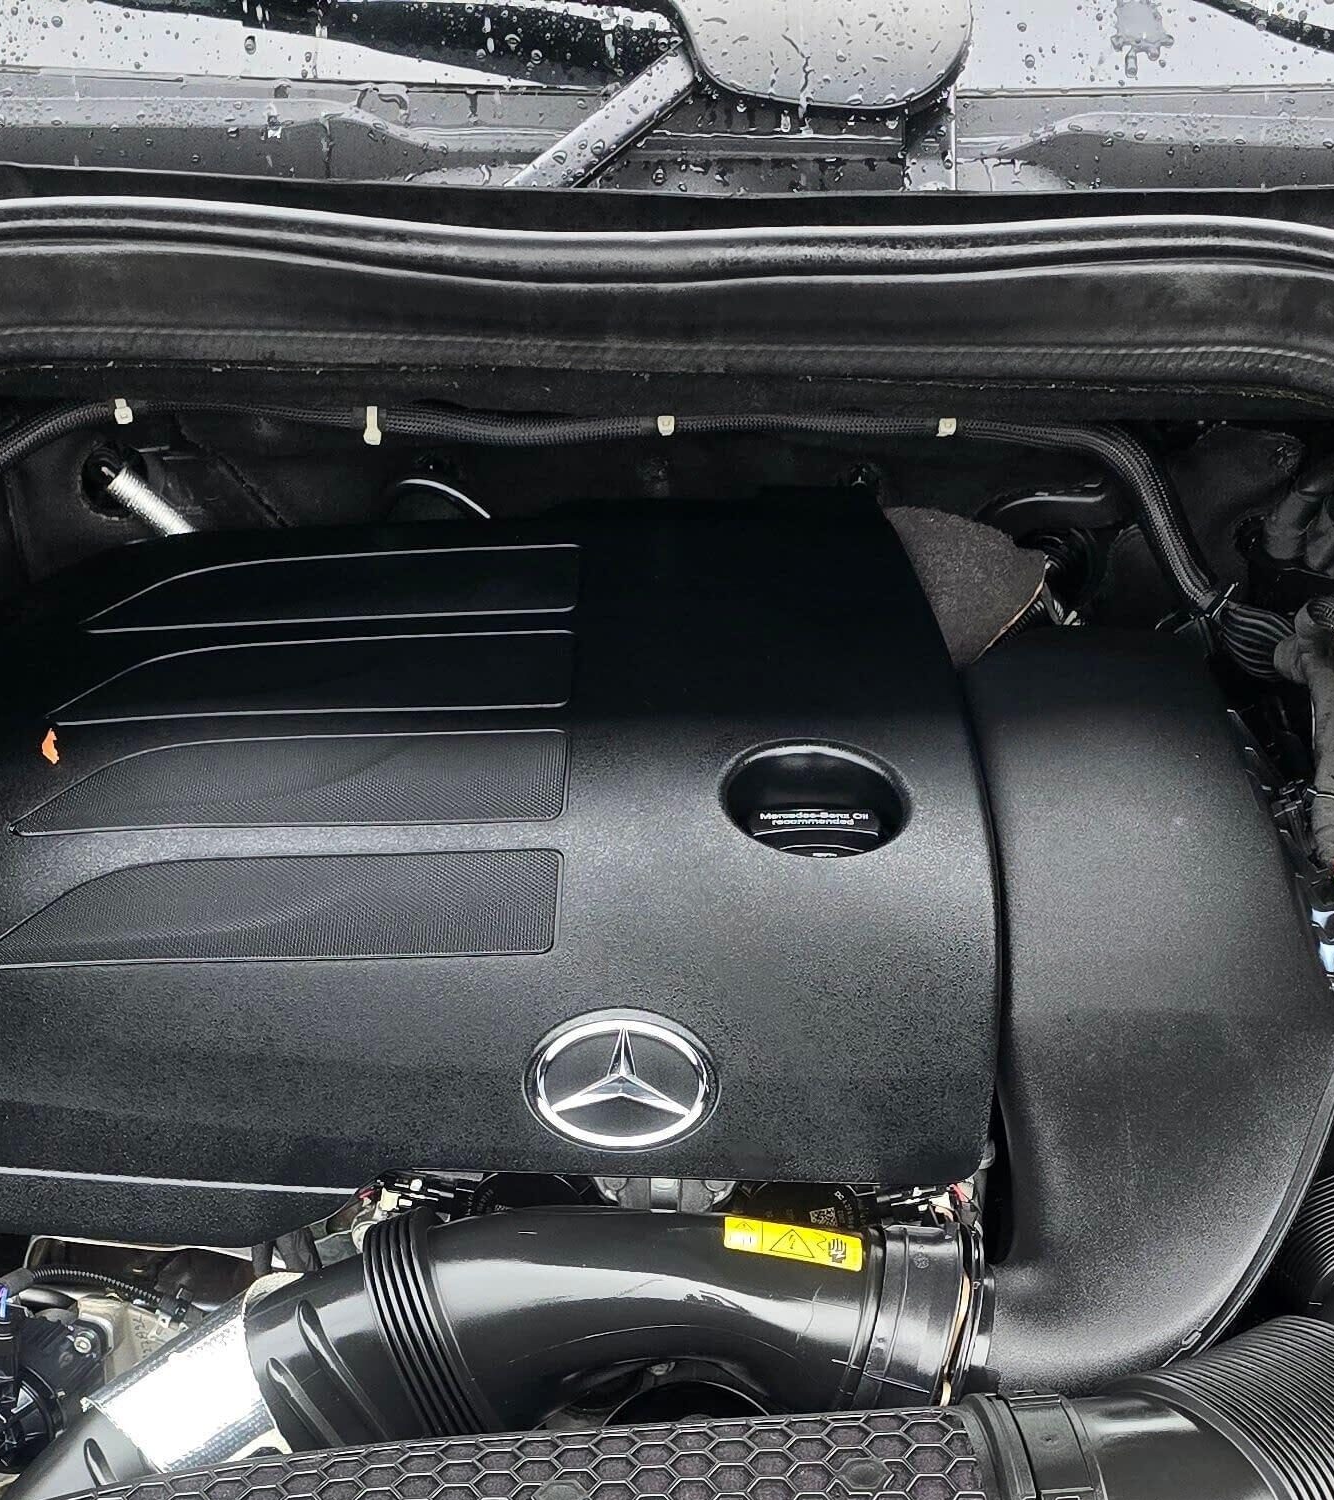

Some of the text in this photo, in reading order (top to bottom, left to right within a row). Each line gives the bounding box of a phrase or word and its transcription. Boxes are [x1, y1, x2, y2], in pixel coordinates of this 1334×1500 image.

[759, 811, 869, 820] Mercedes-Benz Oil
[771, 818, 855, 826] recommended
